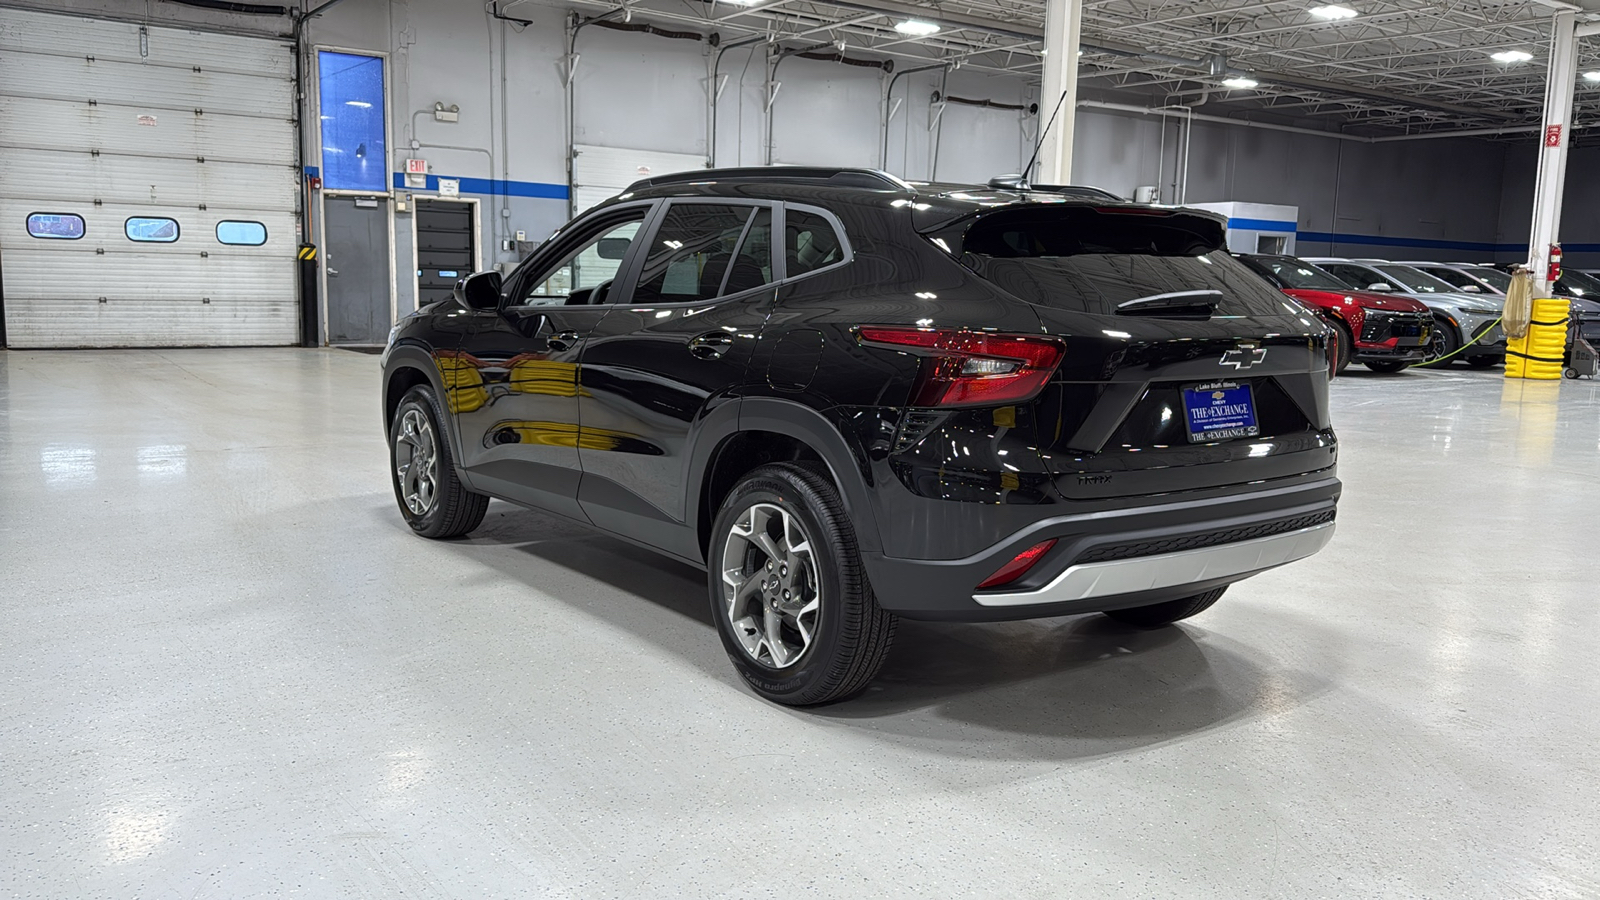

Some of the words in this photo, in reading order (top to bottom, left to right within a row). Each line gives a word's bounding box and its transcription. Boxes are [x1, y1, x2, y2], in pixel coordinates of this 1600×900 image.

[410, 160, 425, 172] EXIT
[1191, 407, 1208, 419] THE
[1210, 403, 1249, 417] EXCHANGE
[1192, 433, 1205, 441] THE
[1210, 428, 1246, 440] EXCHANGE
[1077, 475, 1113, 486] TRAX
